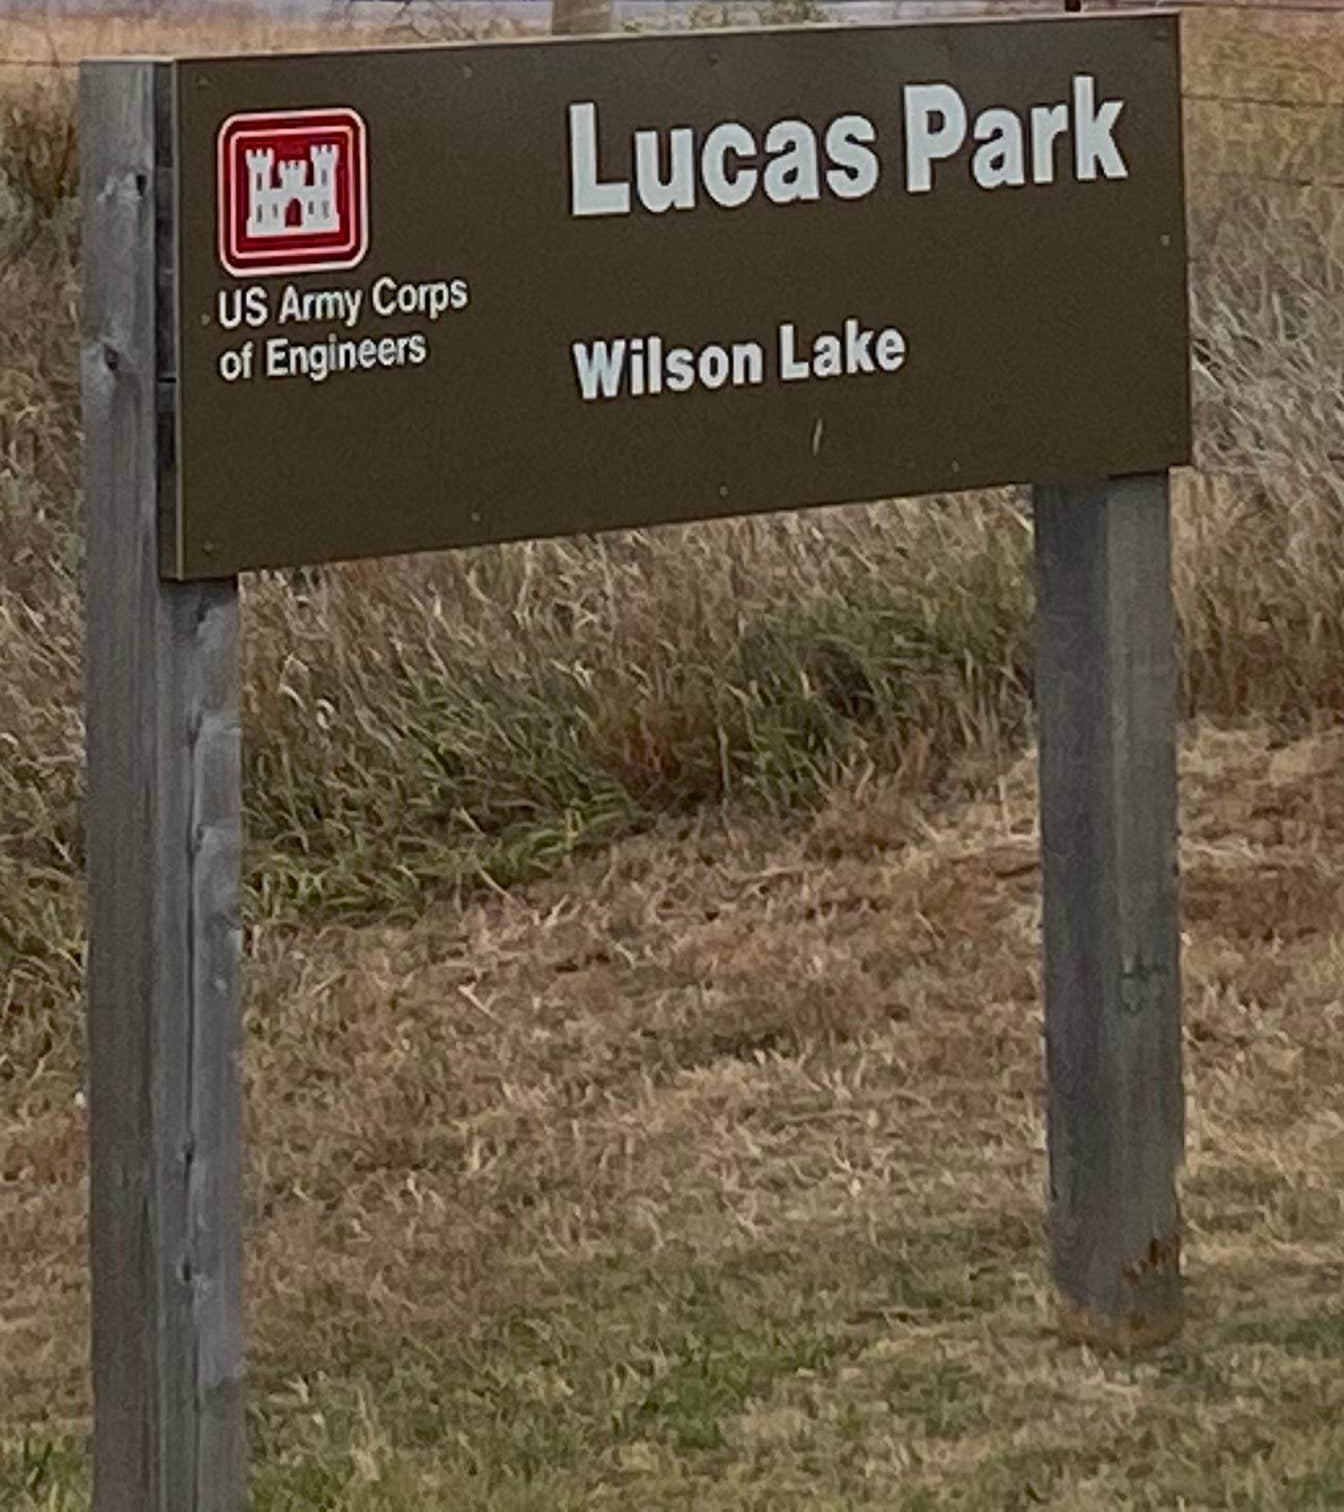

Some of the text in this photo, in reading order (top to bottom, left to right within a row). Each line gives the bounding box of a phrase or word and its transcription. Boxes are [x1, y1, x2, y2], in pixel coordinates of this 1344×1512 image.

[568, 75, 1129, 216] Lucas Park
[218, 276, 469, 329] US Army Corps
[220, 333, 426, 382] of Engineers
[573, 319, 905, 400] Wilson Lake
